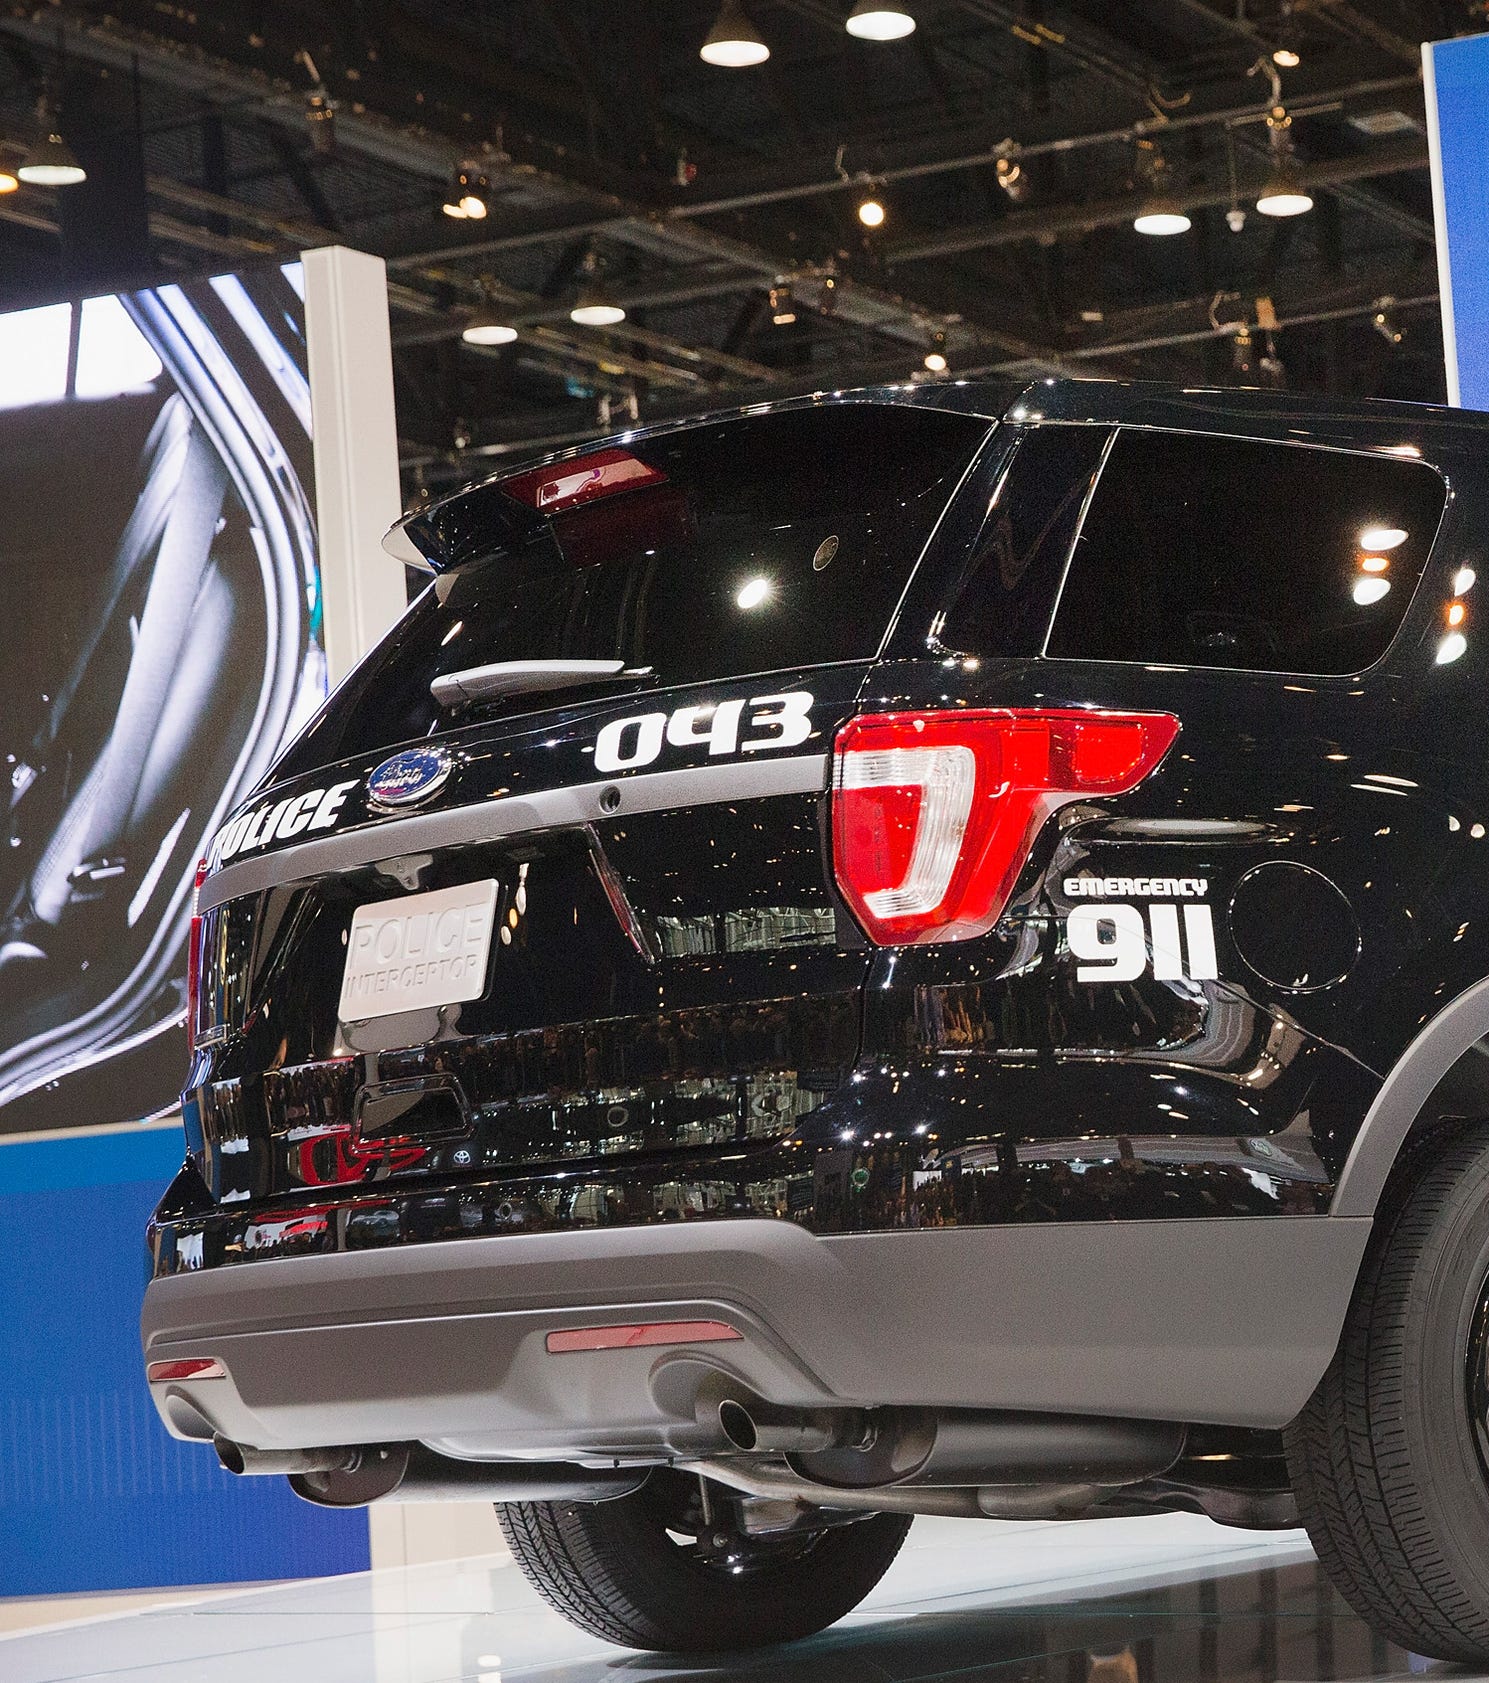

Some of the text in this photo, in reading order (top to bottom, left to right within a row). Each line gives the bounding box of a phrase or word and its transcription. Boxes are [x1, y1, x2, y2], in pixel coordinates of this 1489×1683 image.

[594, 691, 814, 772] 043
[206, 779, 361, 870] POLICE
[1063, 877, 1208, 896] EMERGENCY
[350, 901, 488, 969] POLICE
[1067, 904, 1218, 982] 911
[343, 953, 478, 999] INTERCEPTOR
